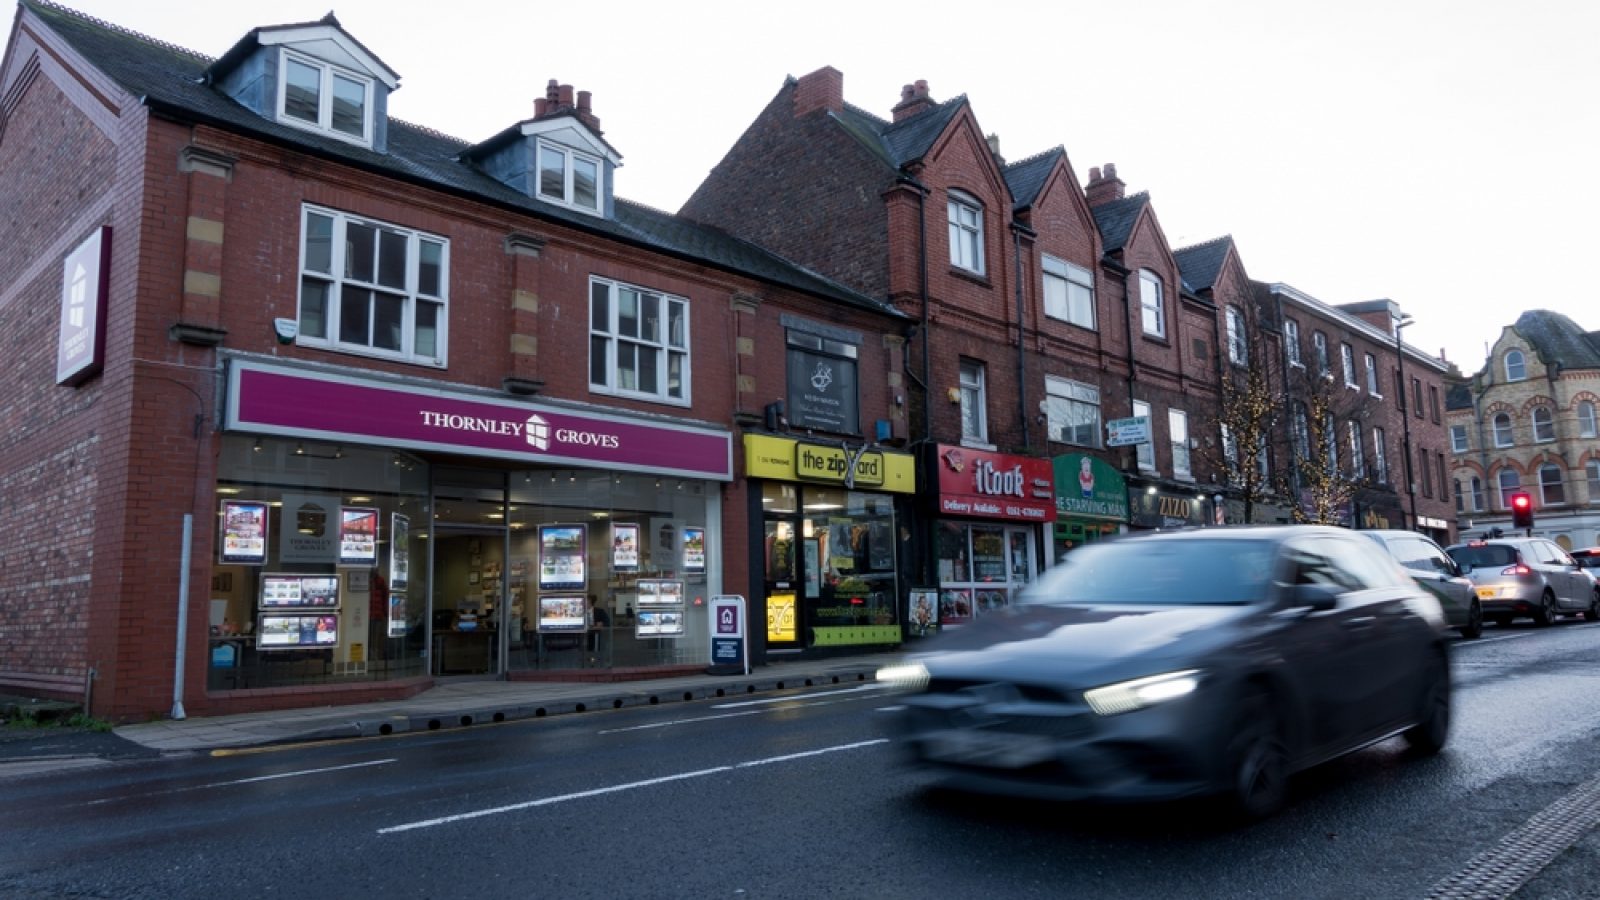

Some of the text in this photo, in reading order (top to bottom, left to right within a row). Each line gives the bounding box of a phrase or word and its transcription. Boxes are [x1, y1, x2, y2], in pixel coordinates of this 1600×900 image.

[420, 410, 619, 449] THORNLEY GROVES
[802, 450, 824, 470] the
[974, 458, 1025, 498] iCook
[1066, 498, 1107, 515] STARVING
[1159, 496, 1190, 519] ZIZO
